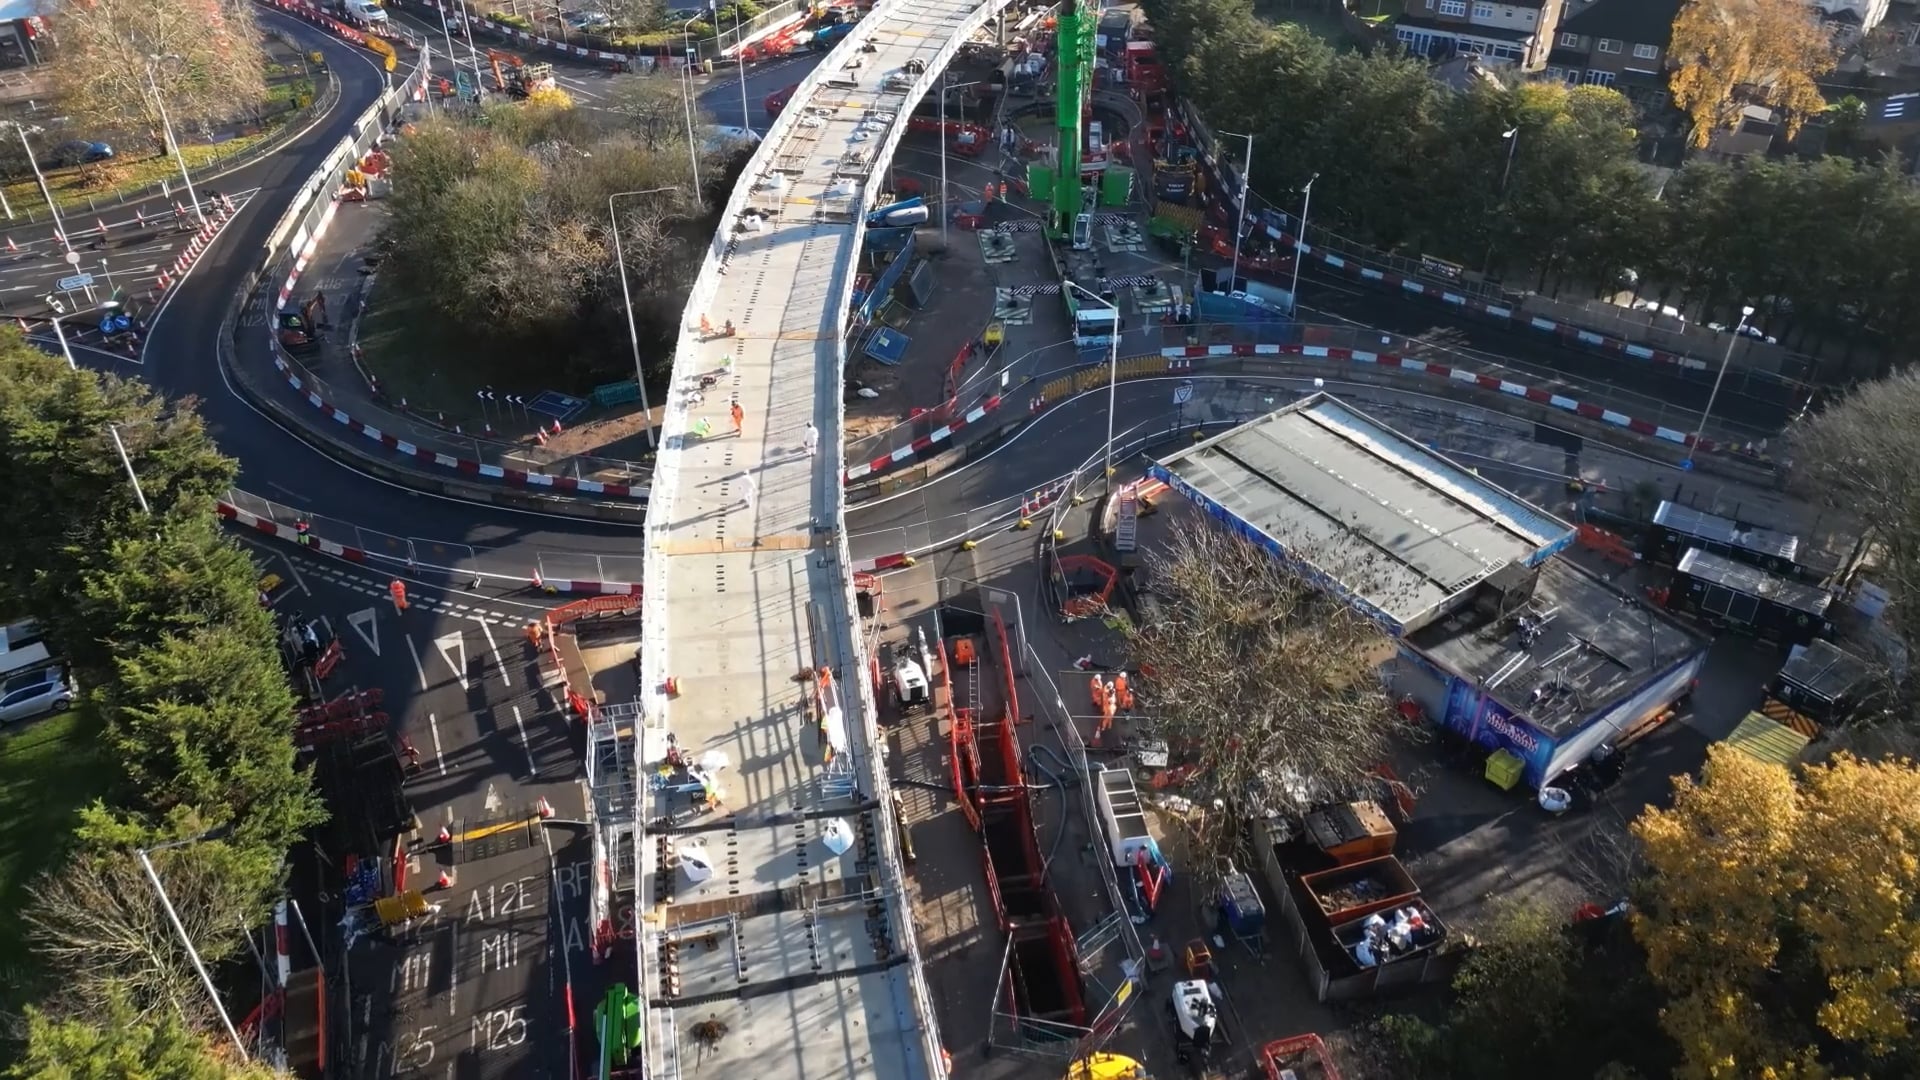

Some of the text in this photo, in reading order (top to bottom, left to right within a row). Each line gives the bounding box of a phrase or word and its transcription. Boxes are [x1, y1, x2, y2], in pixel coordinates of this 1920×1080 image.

[466, 876, 536, 925] A12E
[389, 951, 431, 993] M11
[481, 932, 519, 974] M11
[375, 1025, 438, 1079] M25
[471, 1004, 528, 1055] M25
